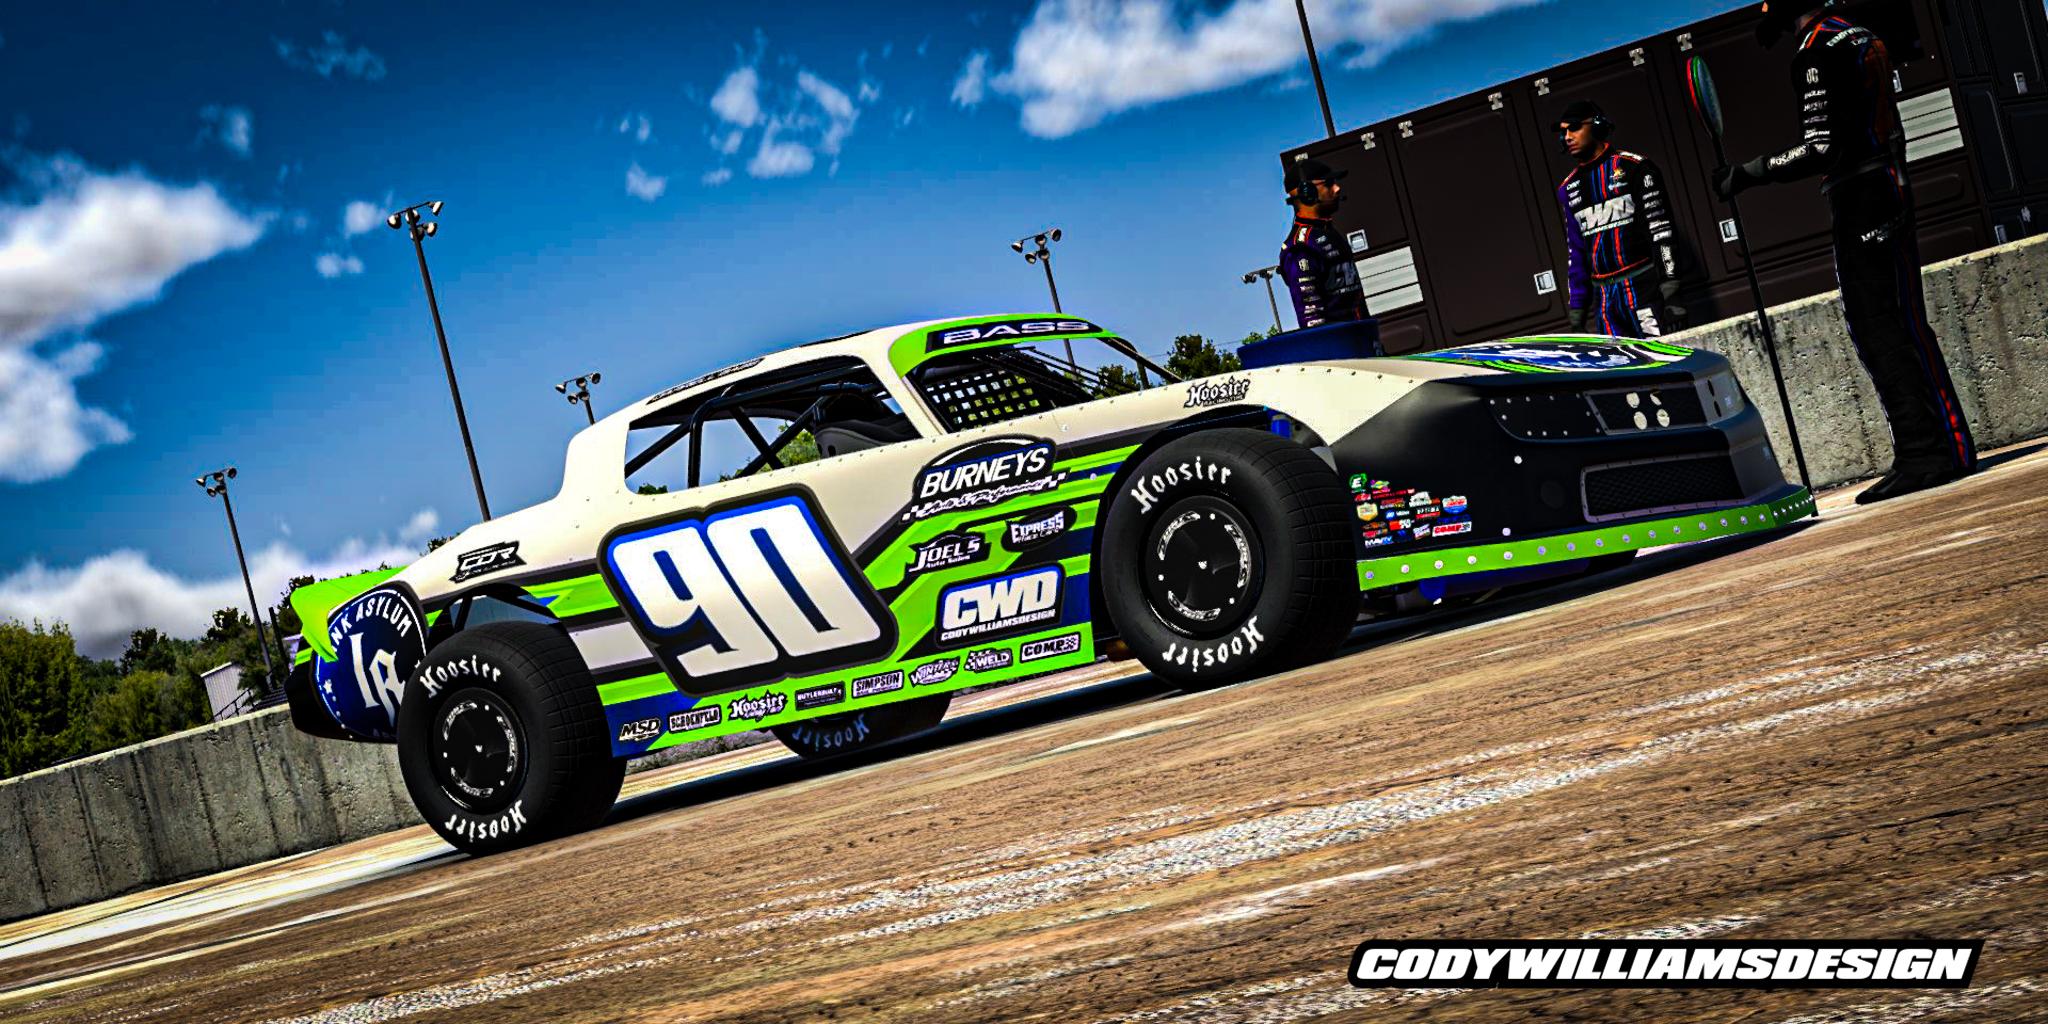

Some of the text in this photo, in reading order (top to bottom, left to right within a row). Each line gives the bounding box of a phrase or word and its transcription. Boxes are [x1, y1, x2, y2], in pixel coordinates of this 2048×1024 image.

[943, 320, 1090, 345] BASS
[1185, 376, 1250, 407] Hoosier
[920, 447, 1049, 499] BURNEYS
[1131, 456, 1232, 514] Hoosier
[1011, 511, 1064, 544] EXPRESS
[612, 503, 881, 678] 90
[942, 569, 1059, 631] CWD
[355, 596, 413, 638] ASYLUM
[941, 608, 1056, 642] CODYWILLIAMSDESIGN
[976, 652, 1010, 668] WELD
[1023, 638, 1065, 657] COMP
[1162, 616, 1265, 673] Hoosier
[419, 654, 502, 699] Hoosier
[855, 673, 901, 692] SIMPSON
[729, 692, 786, 719] Hoosier
[620, 718, 661, 739] MSD
[445, 800, 528, 844] Hoosier
